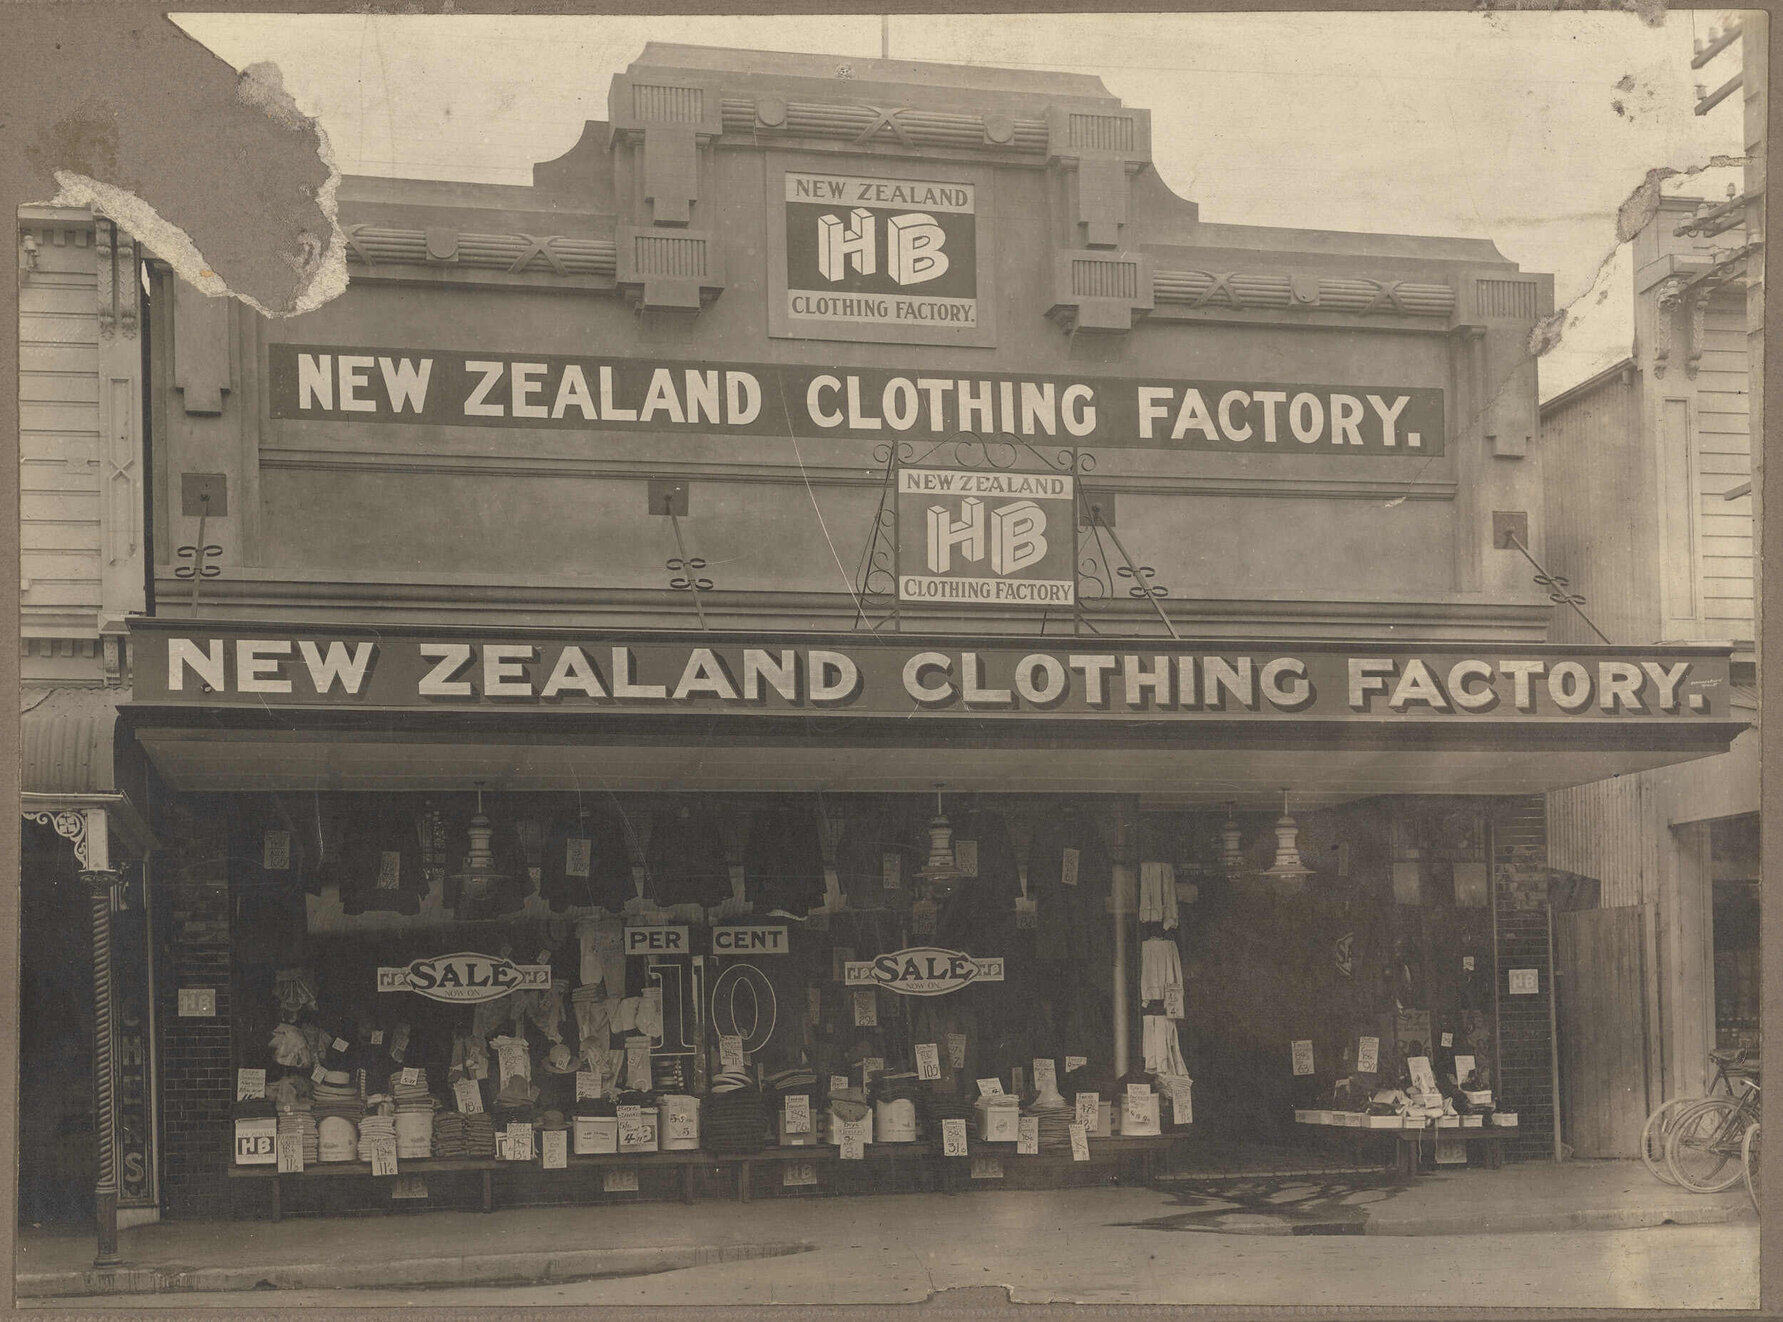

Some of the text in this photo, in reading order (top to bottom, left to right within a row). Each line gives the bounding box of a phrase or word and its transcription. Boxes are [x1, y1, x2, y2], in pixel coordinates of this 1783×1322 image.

[795, 179, 968, 207] NEW ZEALAND
[818, 207, 950, 285] HB
[792, 296, 976, 322] CLOTHING FACTORY.
[297, 353, 1421, 447] NEW ZEALAND CLOTHING FACTORY.
[907, 473, 1064, 495] NEW ZEALAND
[927, 496, 1048, 576] HB
[904, 579, 1072, 601] CLOTHING FACTORY
[168, 637, 1704, 709] NEW ZEALAND CLOTHING FACTORY.
[630, 930, 784, 949] PER CENT
[410, 961, 518, 987] SALE
[875, 956, 973, 983] SALE
[1513, 974, 1535, 989] HB
[444, 990, 464, 998] NOW
[905, 982, 926, 990] NOW
[183, 994, 211, 1012] HB
[648, 962, 777, 1056] 10
[242, 1137, 271, 1155] HB
